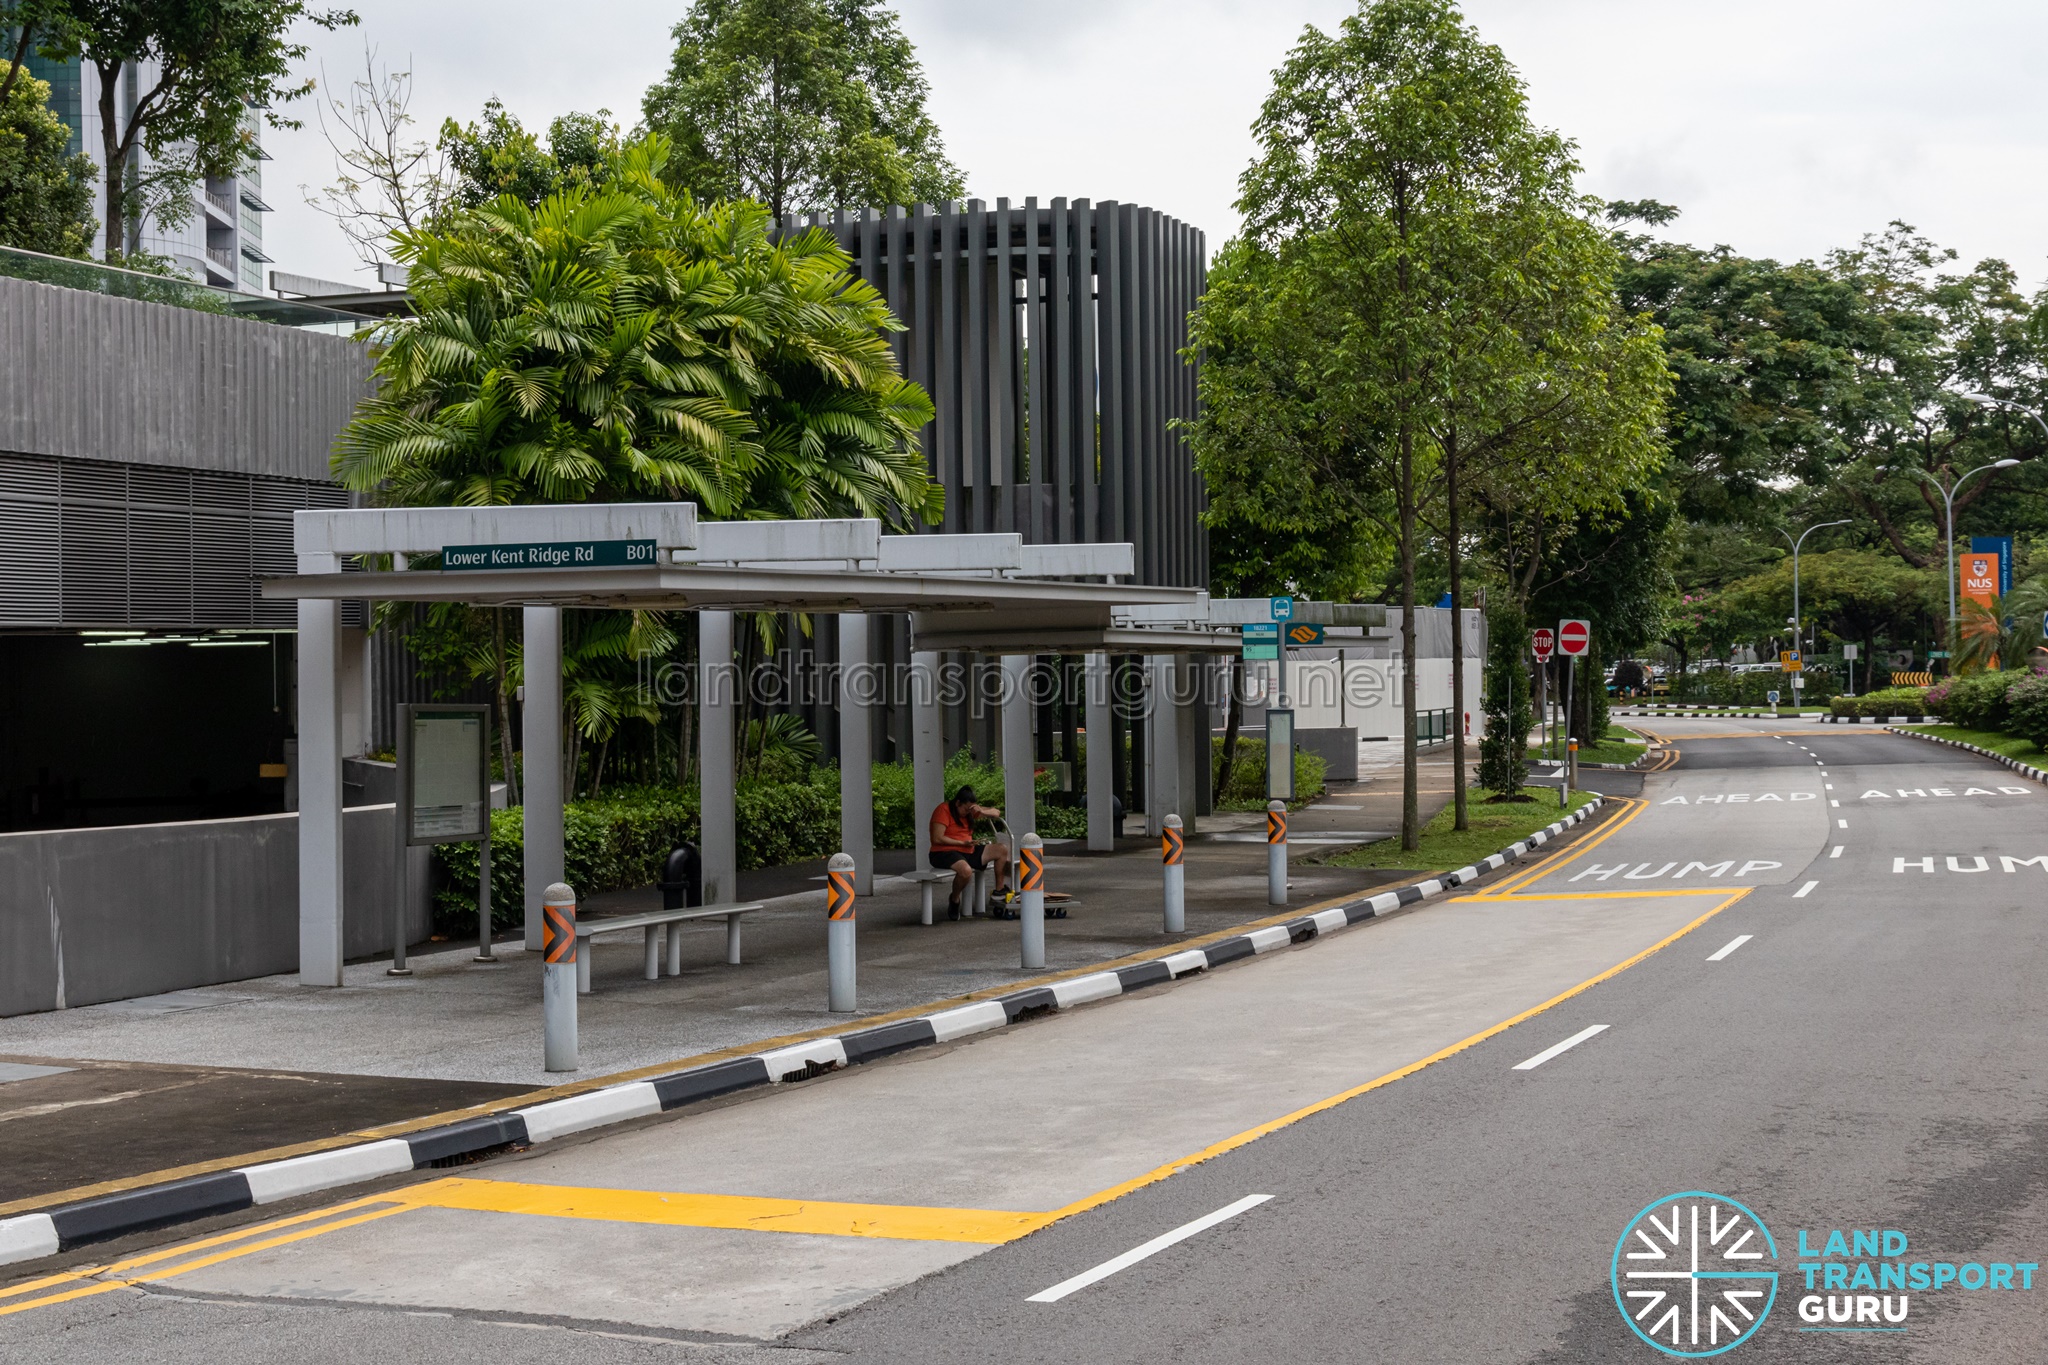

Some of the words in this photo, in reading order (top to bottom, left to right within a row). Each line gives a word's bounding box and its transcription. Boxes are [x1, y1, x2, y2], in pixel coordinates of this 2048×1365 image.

[445, 550, 487, 566] Lower
[491, 548, 524, 564] Kent
[528, 547, 570, 565] Ridge
[574, 545, 594, 562] Rd
[626, 544, 654, 560] B01
[1967, 577, 1993, 588] NUS
[1533, 636, 1553, 648] STOP
[1659, 792, 1817, 805] AHEAD
[1859, 786, 2032, 799] AHEAD
[1567, 860, 1783, 882] HUMP
